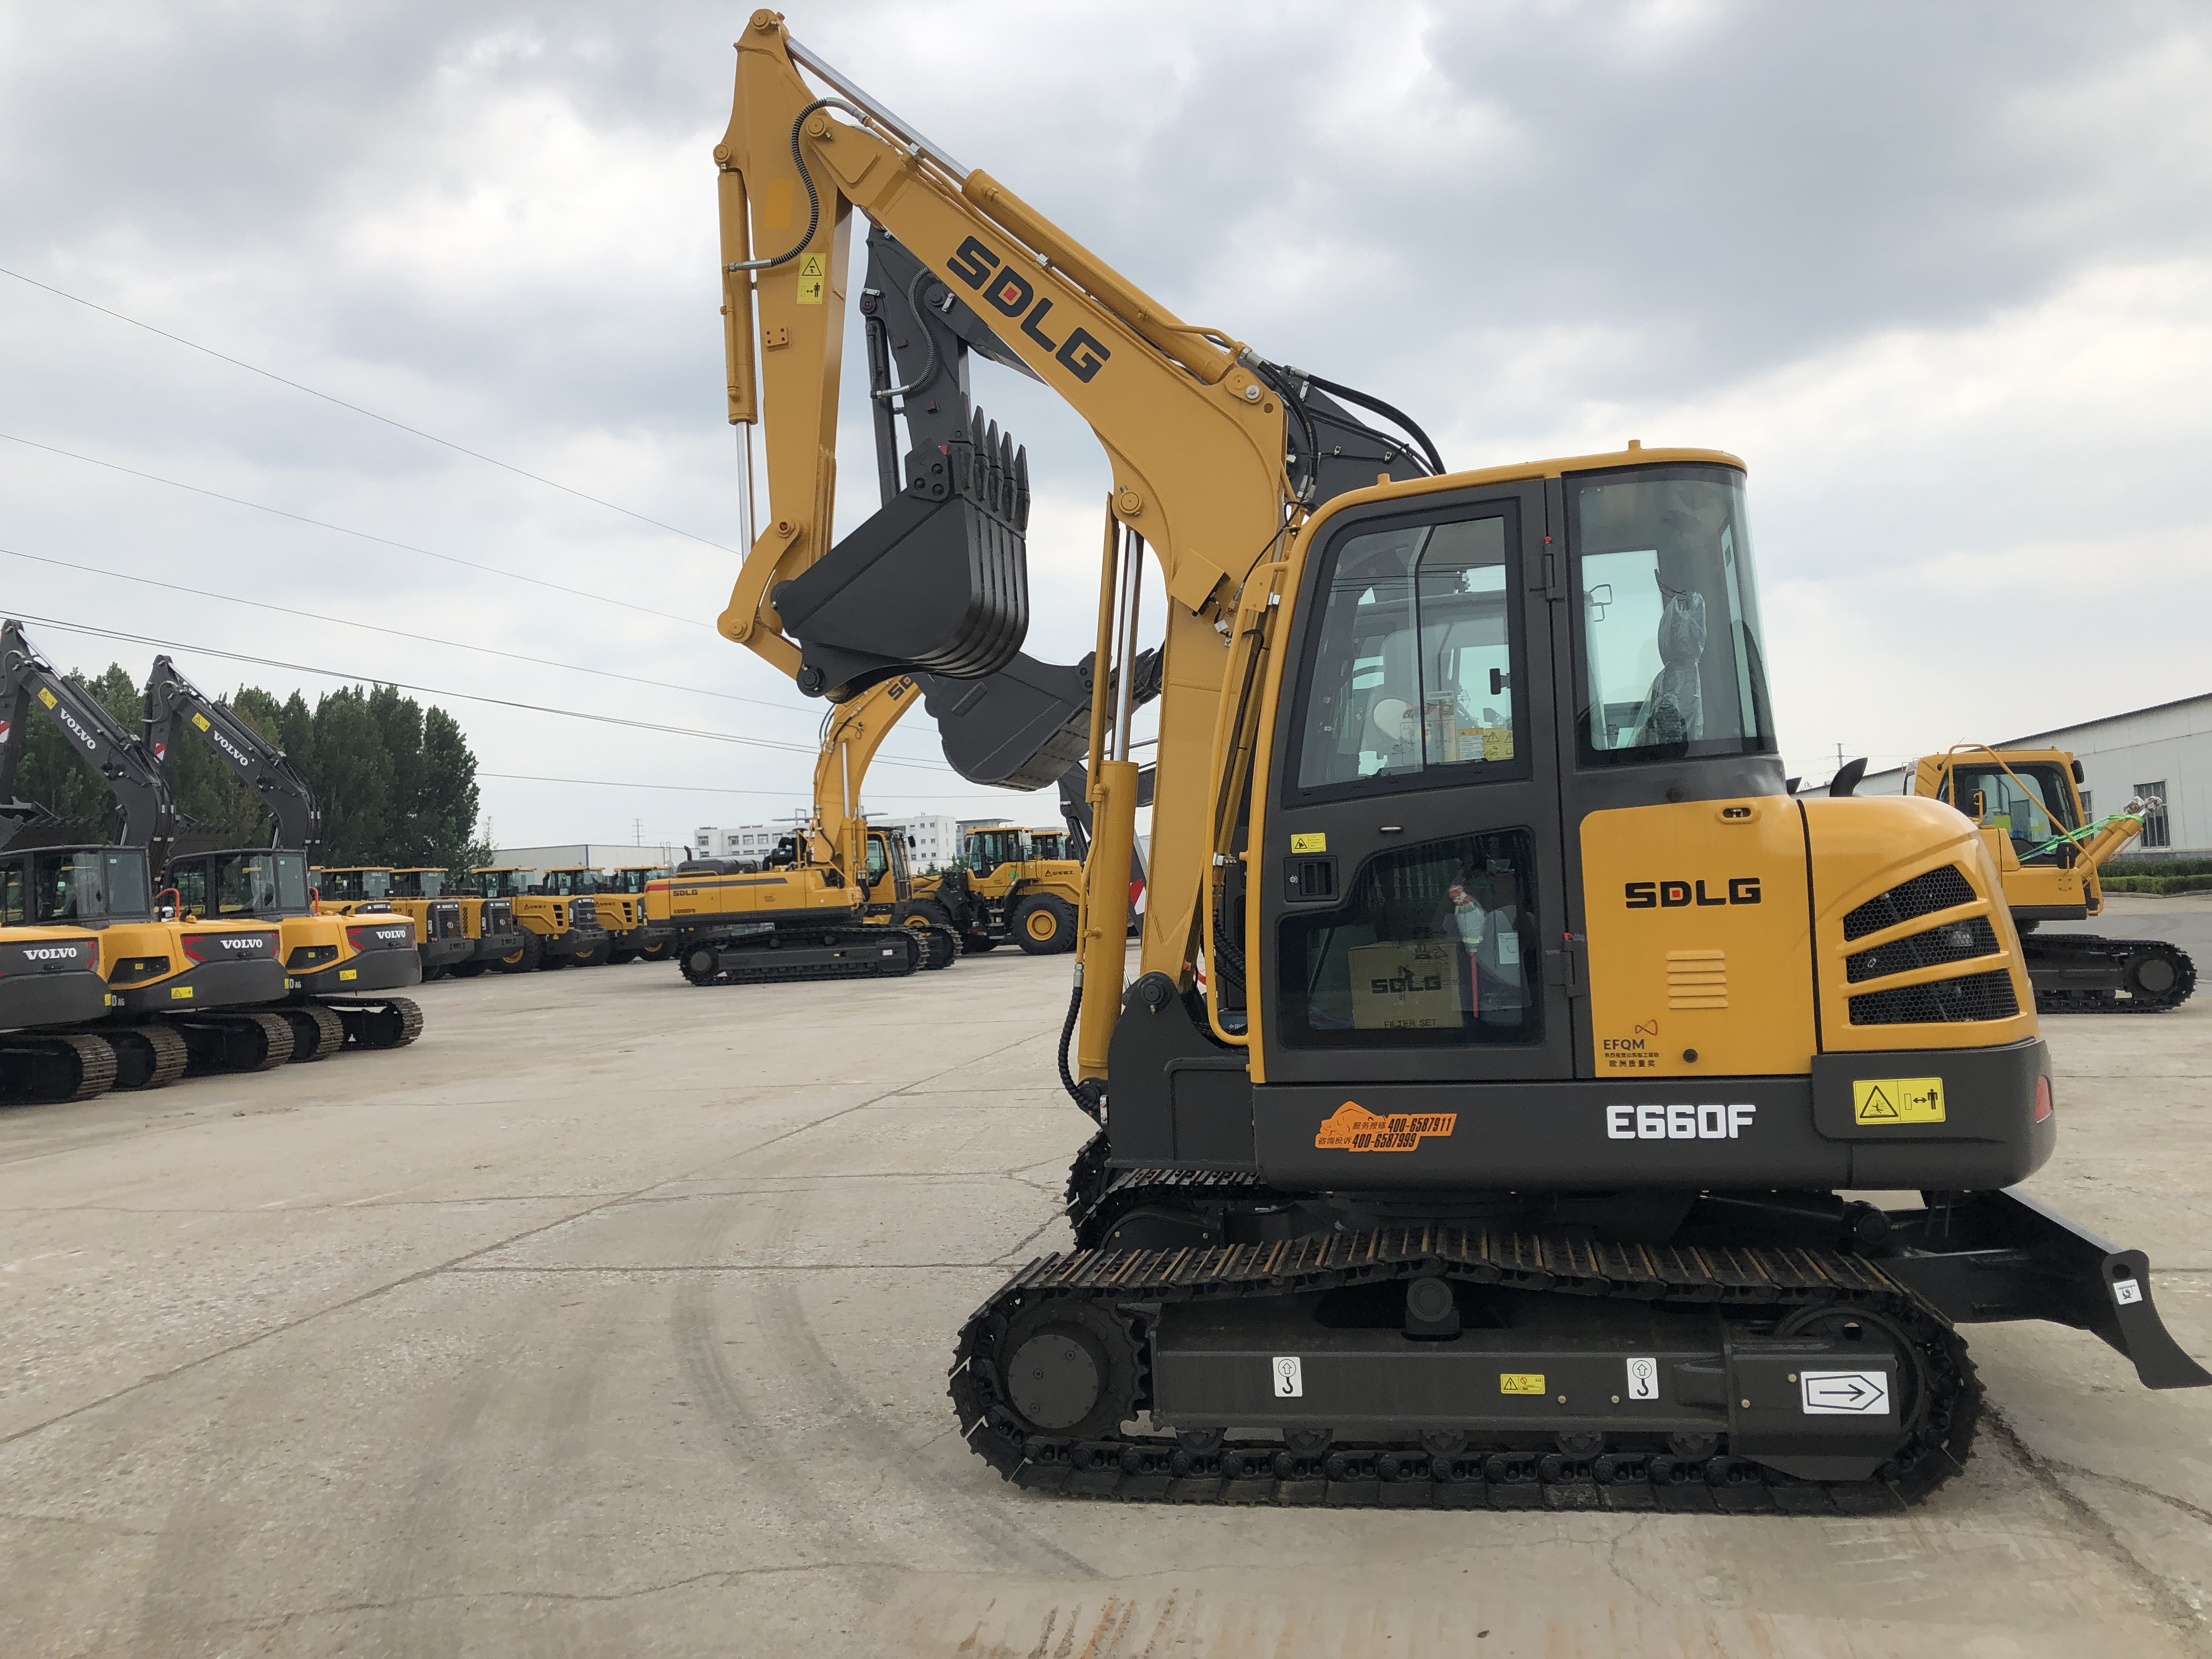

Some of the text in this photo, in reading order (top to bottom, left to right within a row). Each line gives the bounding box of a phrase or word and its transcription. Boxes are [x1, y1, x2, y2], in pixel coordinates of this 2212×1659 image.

[946, 235, 1111, 383] SDLG
[60, 708, 96, 749] VOLVO
[213, 731, 249, 766] VOLVO
[1624, 878, 1762, 909] SDLG
[376, 930, 406, 939] VOLVO
[221, 939, 263, 949] VOLVO
[23, 947, 77, 960] VOLVO
[1372, 976, 1442, 994] SDLG
[1384, 1018, 1437, 1028] FILTER SET
[1604, 1039, 1645, 1051] EFQM
[1388, 1118, 1452, 1132] 400-6587911
[1607, 1104, 1757, 1139] E660F
[1318, 1133, 1417, 1148] 咨询投诉 400-6587999
